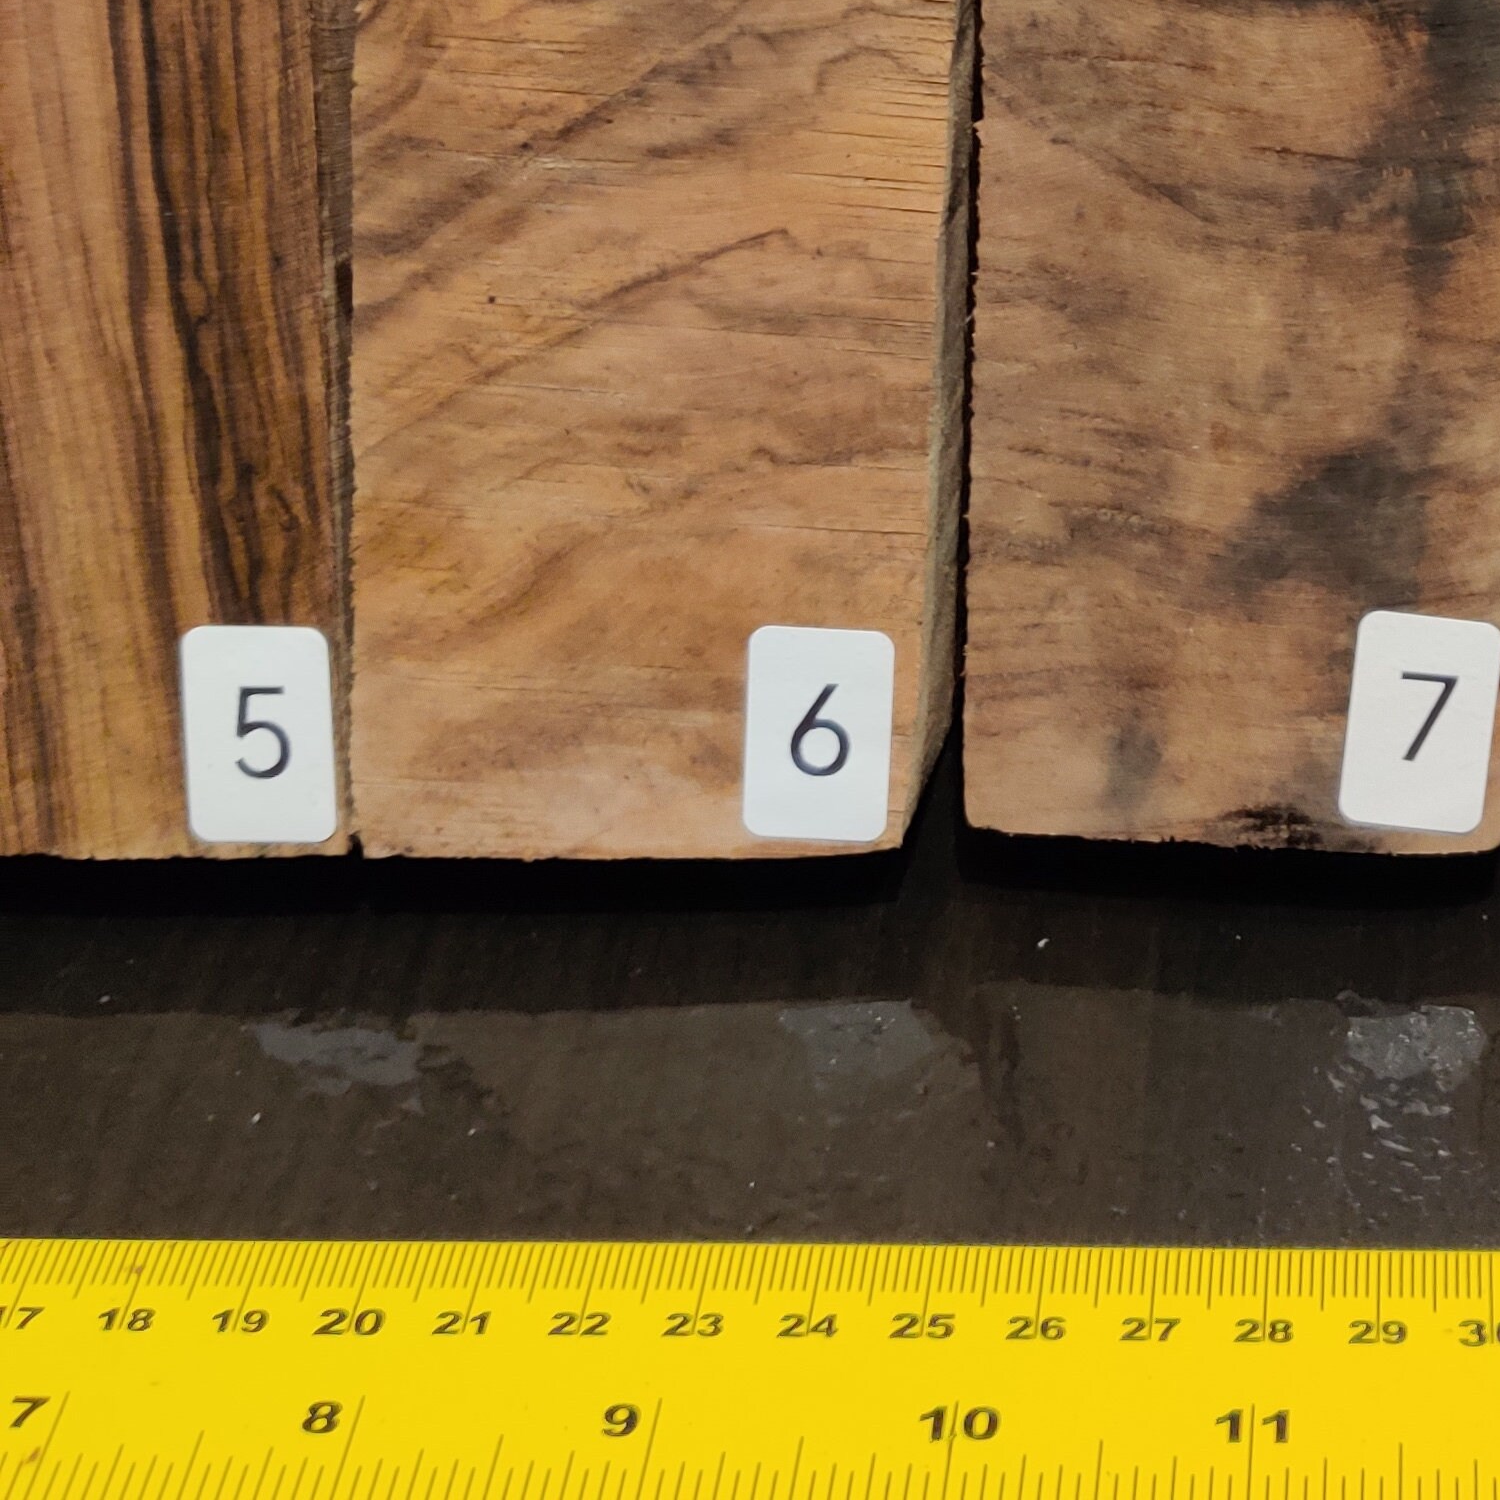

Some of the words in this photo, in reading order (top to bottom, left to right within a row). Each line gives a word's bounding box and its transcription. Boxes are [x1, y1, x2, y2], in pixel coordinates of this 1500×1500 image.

[235, 685, 291, 781] 5
[789, 683, 850, 777] 6
[1399, 671, 1460, 763] 7
[98, 1307, 155, 1331] 18
[210, 1308, 269, 1333] 19
[312, 1308, 386, 1336] 20
[431, 1311, 491, 1336] 21
[547, 1313, 610, 1337] 22
[662, 1313, 724, 1338] 23
[777, 1315, 838, 1339] 24
[889, 1314, 955, 1340] 25
[1006, 1317, 1065, 1341] 26
[1120, 1318, 1180, 1342] 27
[1234, 1320, 1293, 1344] 28
[1348, 1321, 1407, 1345] 29
[10, 1396, 50, 1429] 7
[302, 1401, 342, 1435] 8
[602, 1404, 640, 1438] 9
[919, 1407, 999, 1442] 10
[1214, 1410, 1291, 1444] 11
